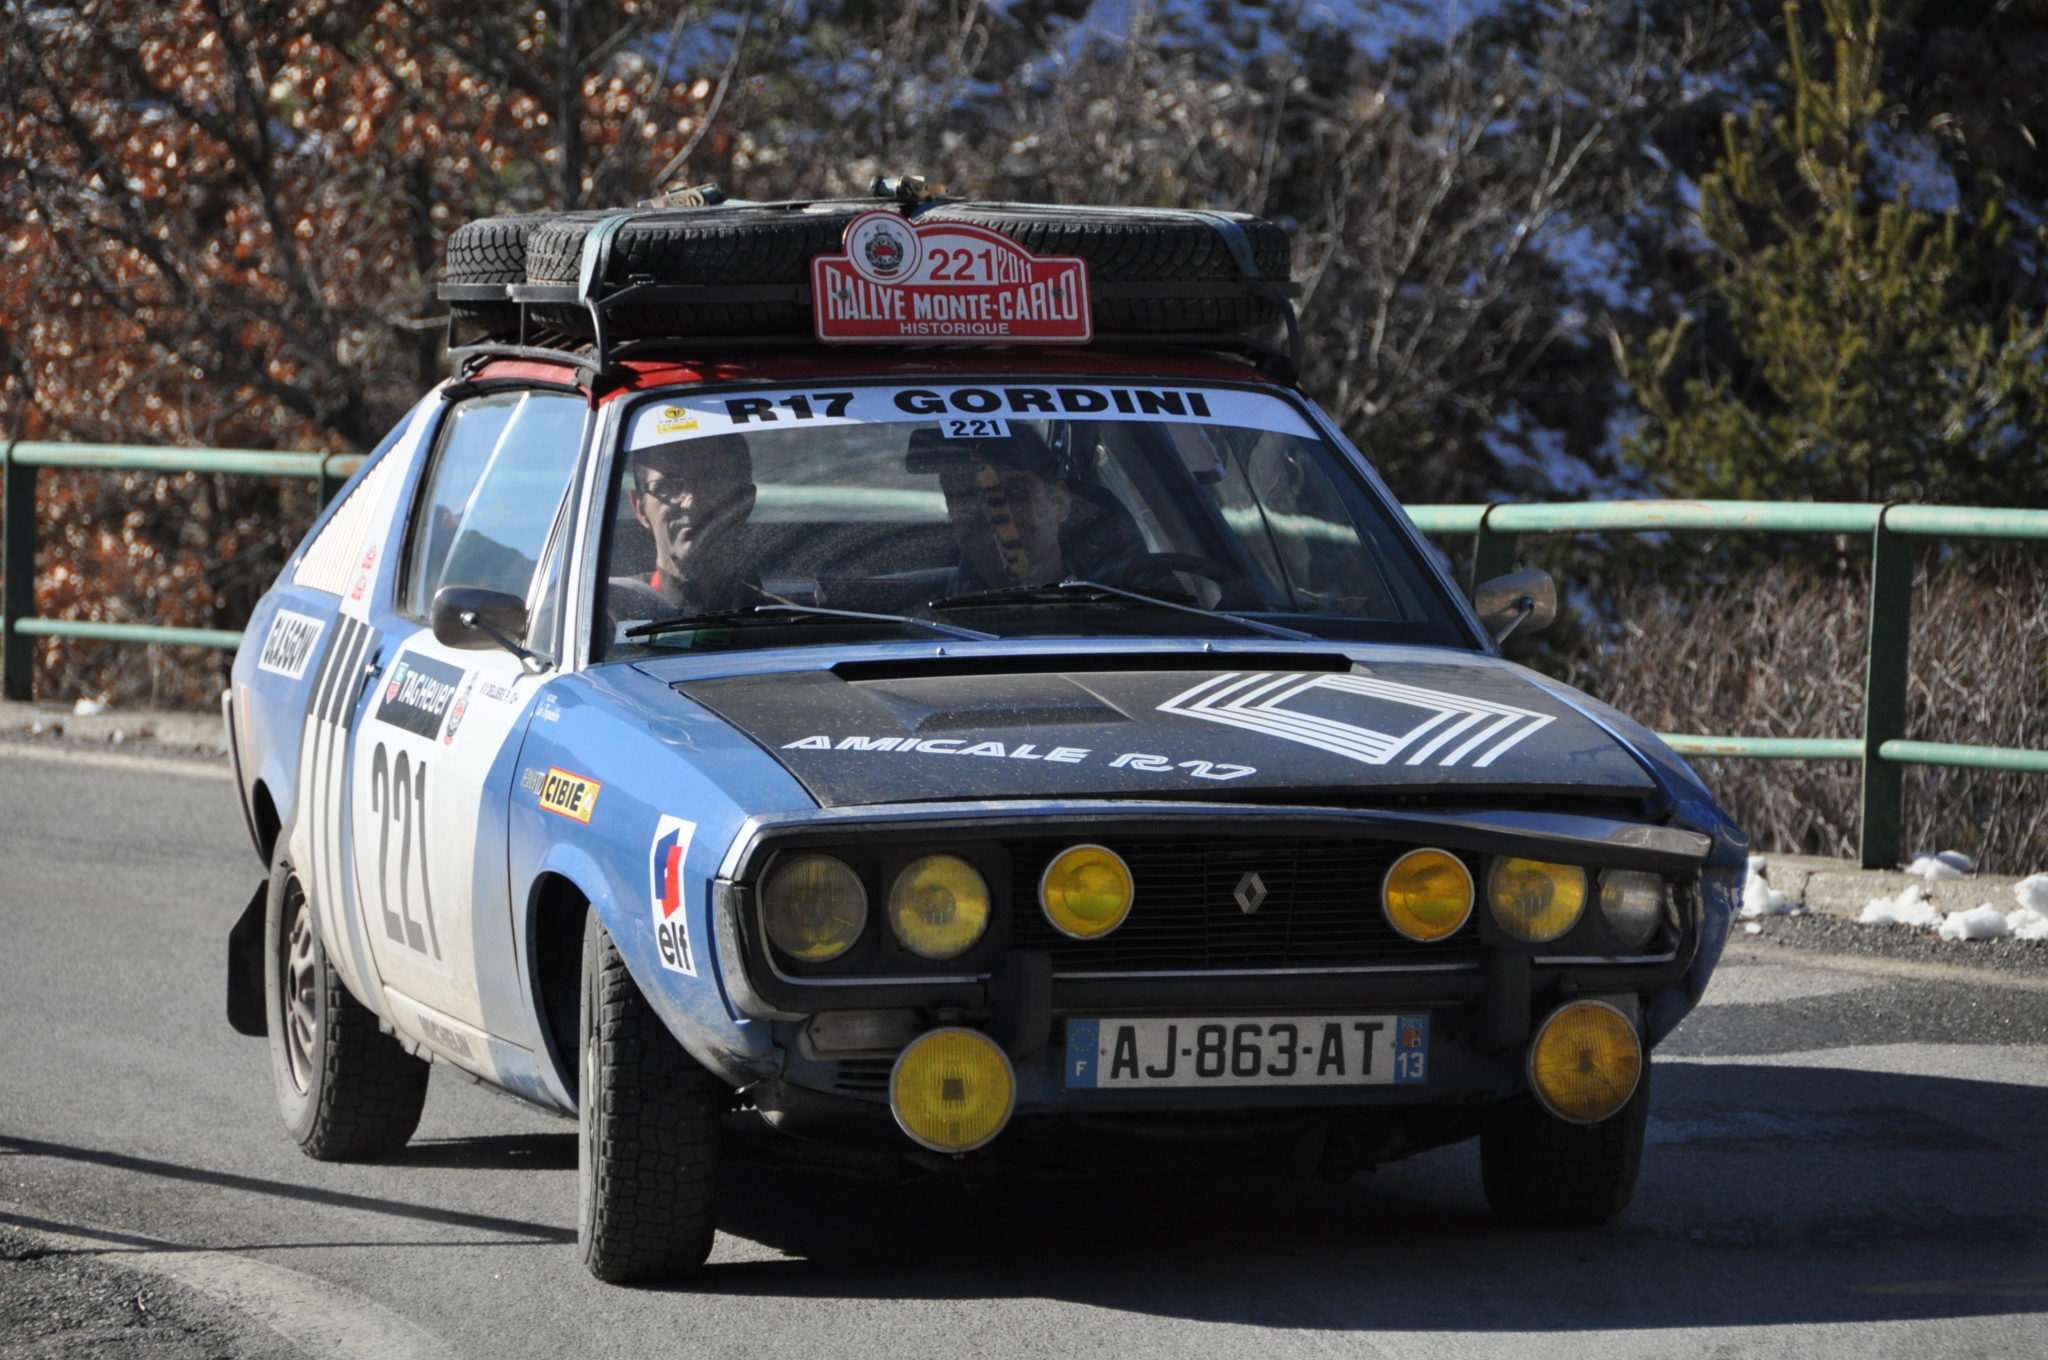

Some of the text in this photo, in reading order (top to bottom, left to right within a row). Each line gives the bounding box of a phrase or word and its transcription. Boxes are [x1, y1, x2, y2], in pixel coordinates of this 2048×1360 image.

[928, 249, 994, 281] 221
[998, 247, 1033, 284] 2011
[825, 265, 1079, 321] RALLYE MONTE-CARLO
[900, 322, 1010, 336] HISTORIQUE
[724, 388, 1212, 425] R17 GORDINI
[949, 419, 1001, 437] 221
[781, 735, 1093, 763] AMICALE
[371, 741, 443, 962] 221
[658, 921, 691, 972] elf
[1075, 1061, 1085, 1077] F
[1110, 1022, 1384, 1080] AJ-863-AT
[1397, 1051, 1425, 1078] 13
